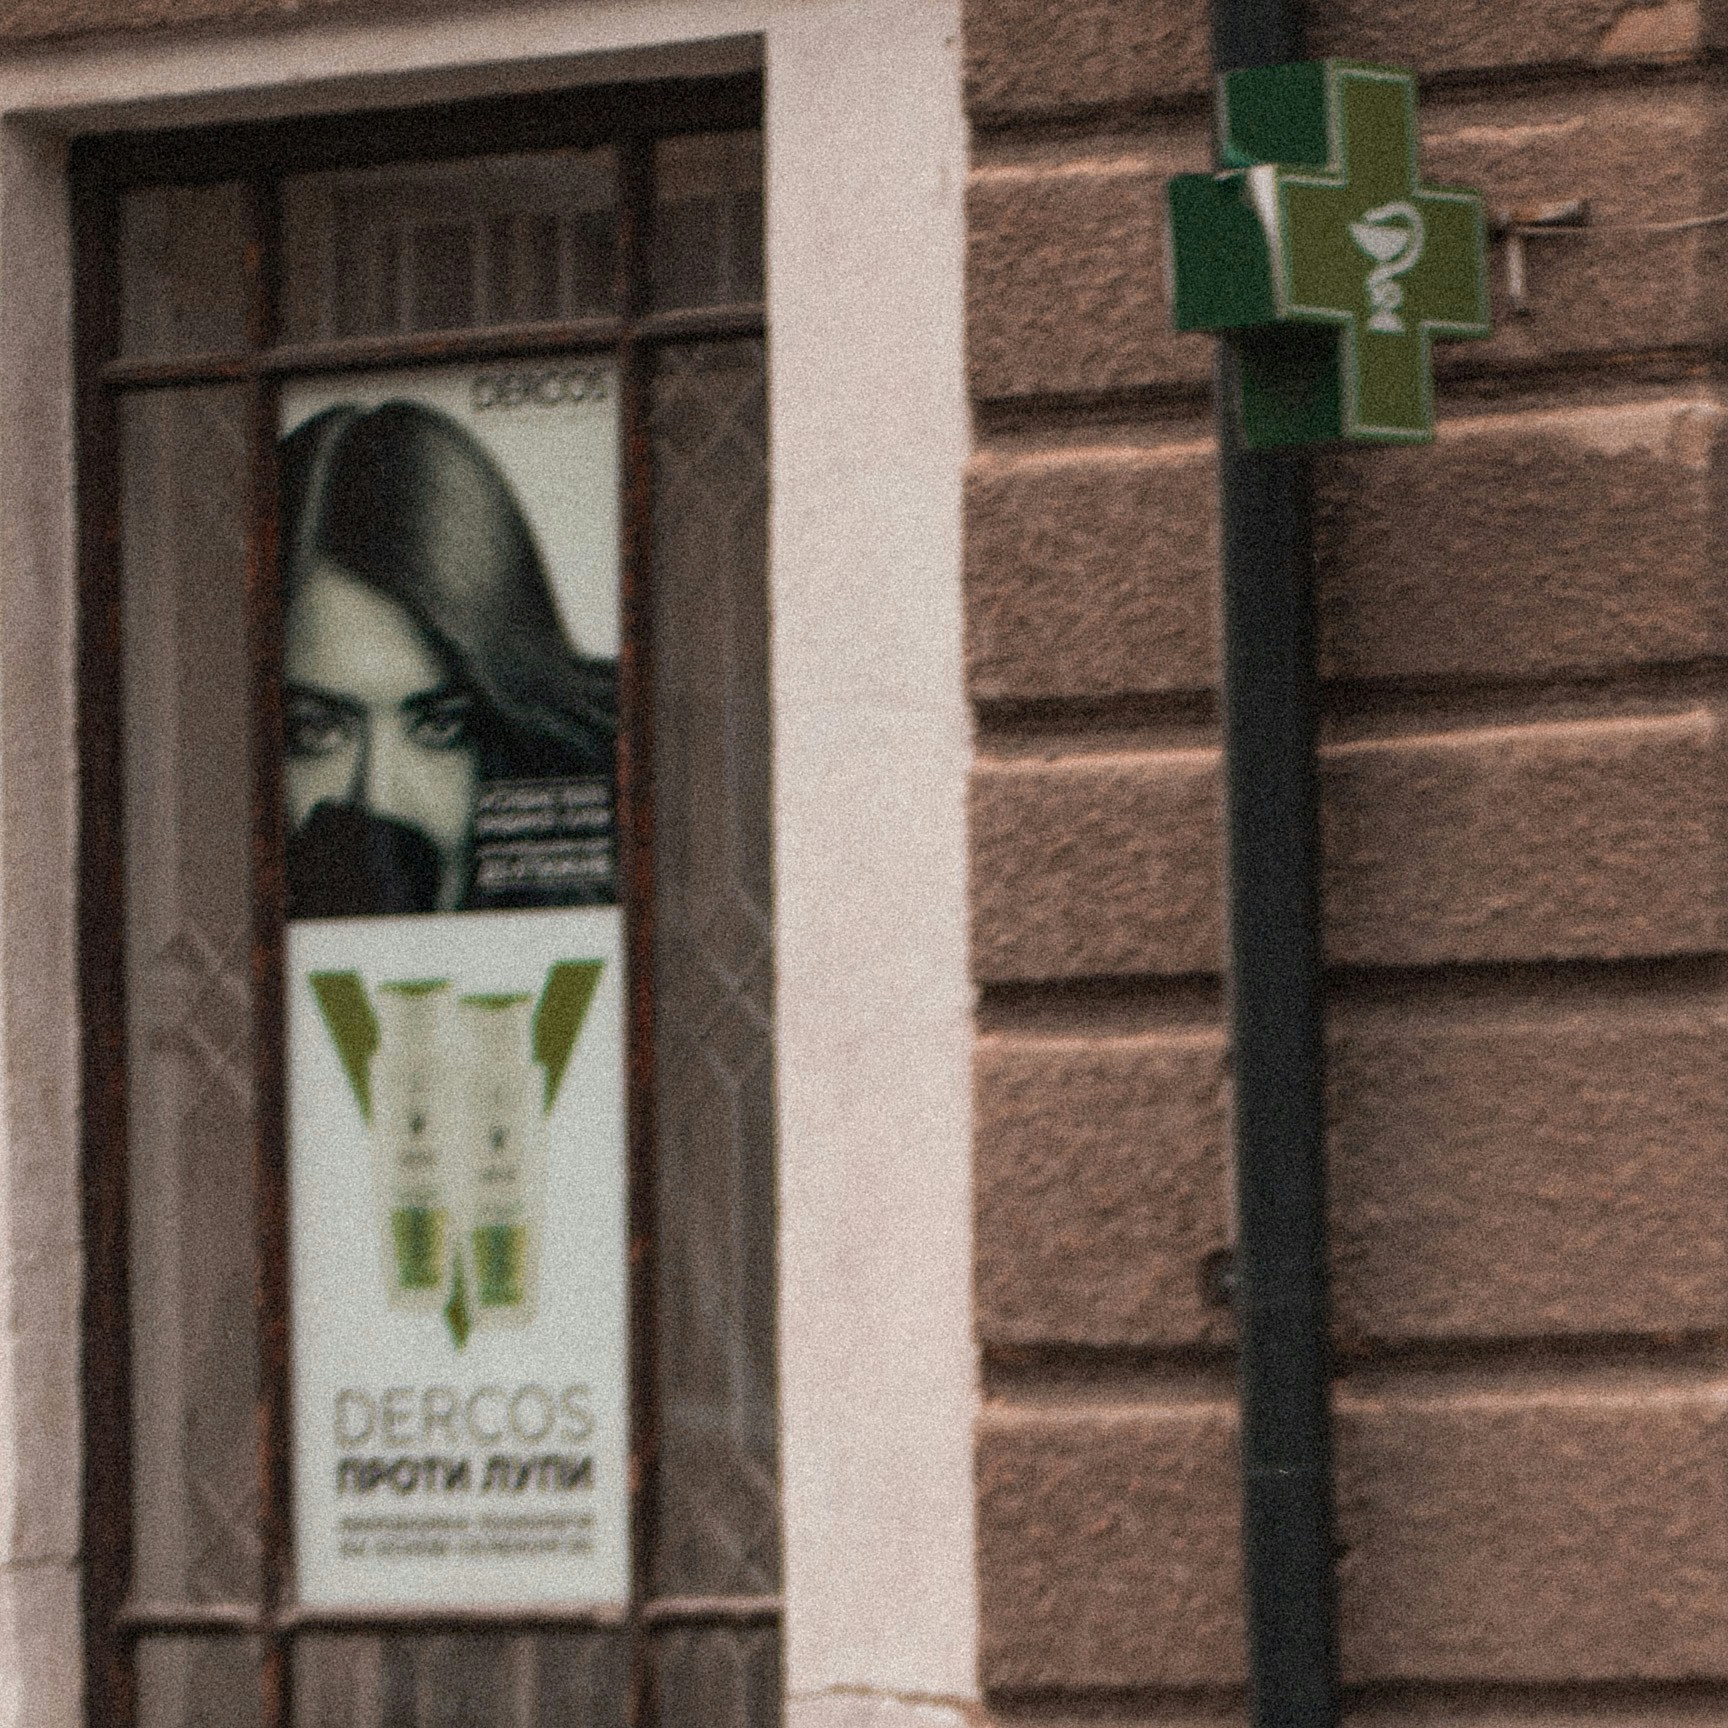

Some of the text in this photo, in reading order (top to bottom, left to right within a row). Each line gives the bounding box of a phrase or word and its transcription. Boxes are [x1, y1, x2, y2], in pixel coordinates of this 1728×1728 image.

[471, 368, 609, 411] DERCOS
[334, 1383, 596, 1450] DERCOS
[337, 1453, 595, 1496] ПРОТИ ЛУПИ
